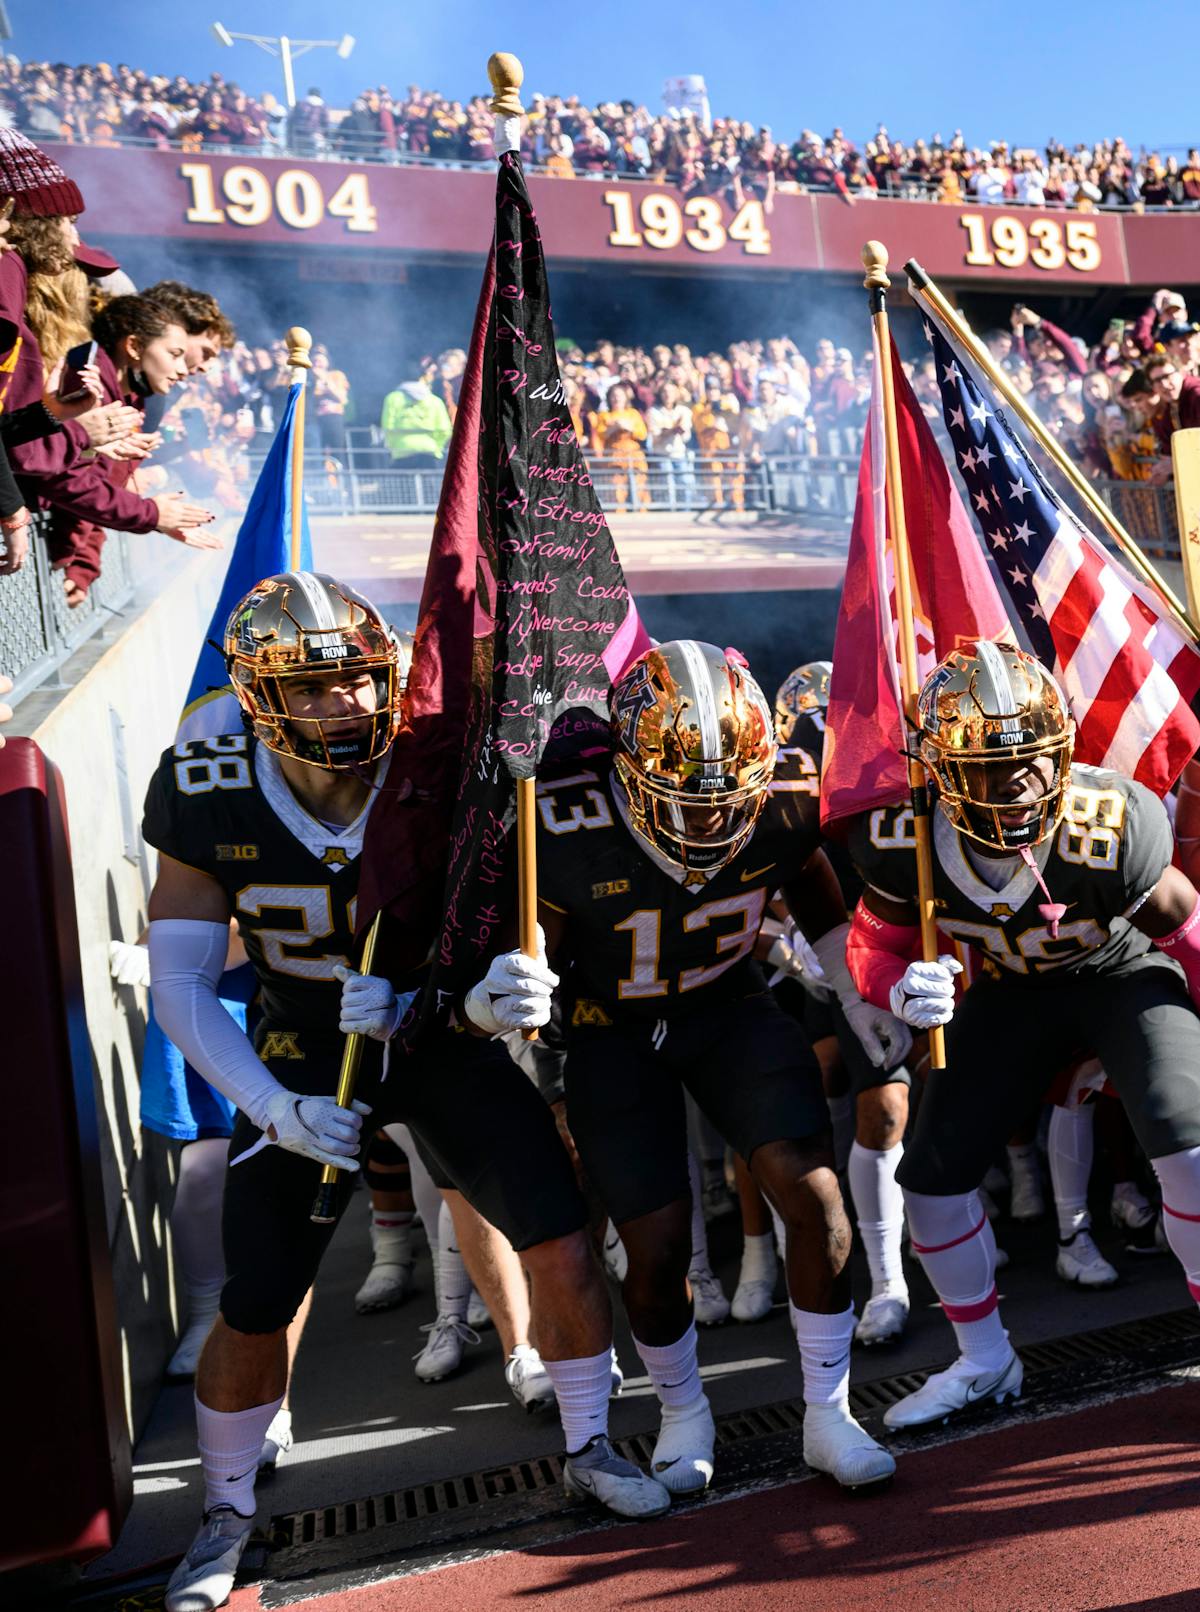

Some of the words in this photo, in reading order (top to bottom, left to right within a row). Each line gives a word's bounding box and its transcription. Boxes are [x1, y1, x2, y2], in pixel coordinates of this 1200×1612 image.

[181, 163, 378, 232] 1904
[605, 190, 771, 255] 1934
[961, 214, 1102, 270] 1935
[321, 646, 348, 659] ROW
[1000, 732, 1024, 746] ROW
[700, 778, 726, 789] ROW
[236, 883, 358, 981] 2
[613, 886, 768, 1000] 13
